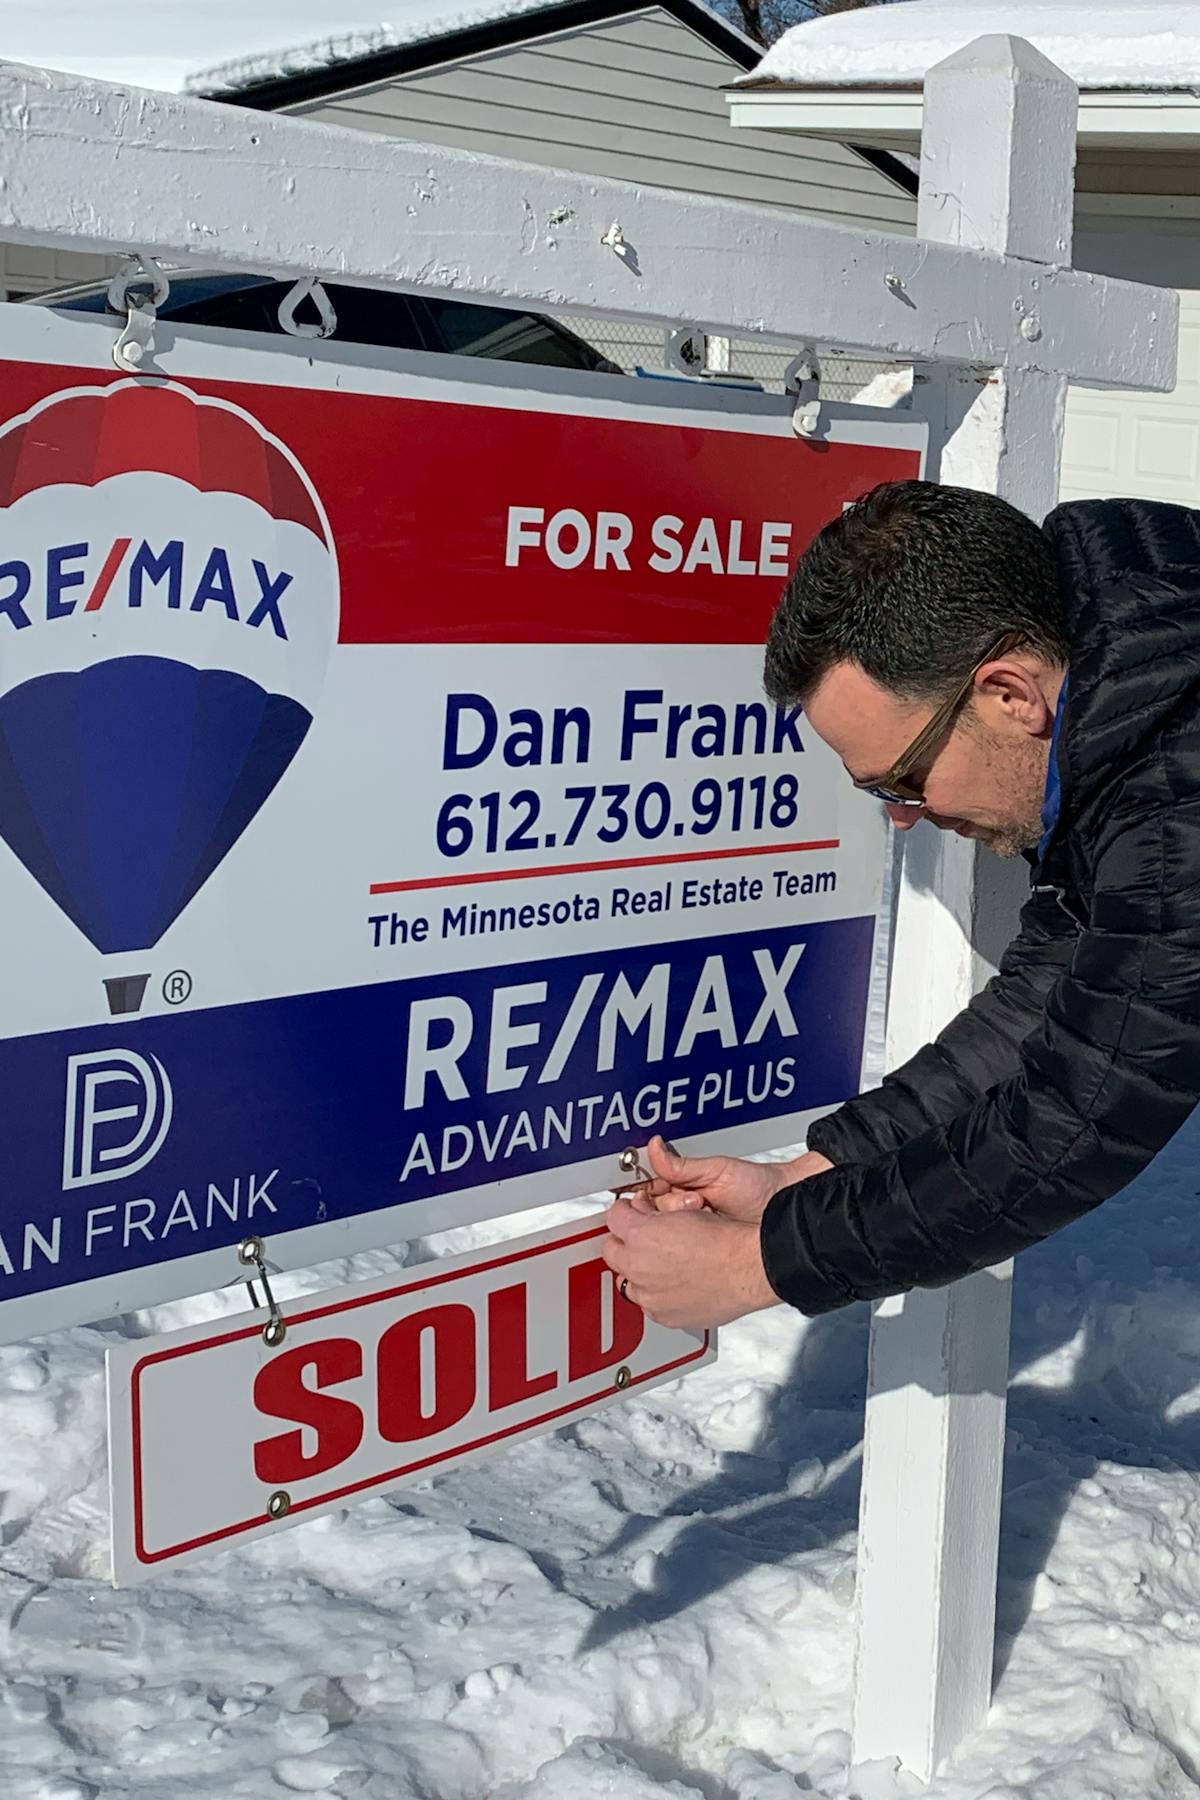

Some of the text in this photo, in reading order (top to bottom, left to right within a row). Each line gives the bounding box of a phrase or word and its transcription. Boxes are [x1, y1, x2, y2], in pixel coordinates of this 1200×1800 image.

[505, 506, 792, 577] FOR SALE
[442, 689, 805, 770] Dan Frank
[436, 774, 799, 858] 612.730.9118
[369, 869, 836, 946] The Minnesota Real Estate Team
[403, 943, 806, 1111] RE/MAX
[399, 1056, 797, 1182] ADVANTAGE PLUS
[85, 1168, 280, 1256] FRANK
[253, 1257, 644, 1484] SOLD
